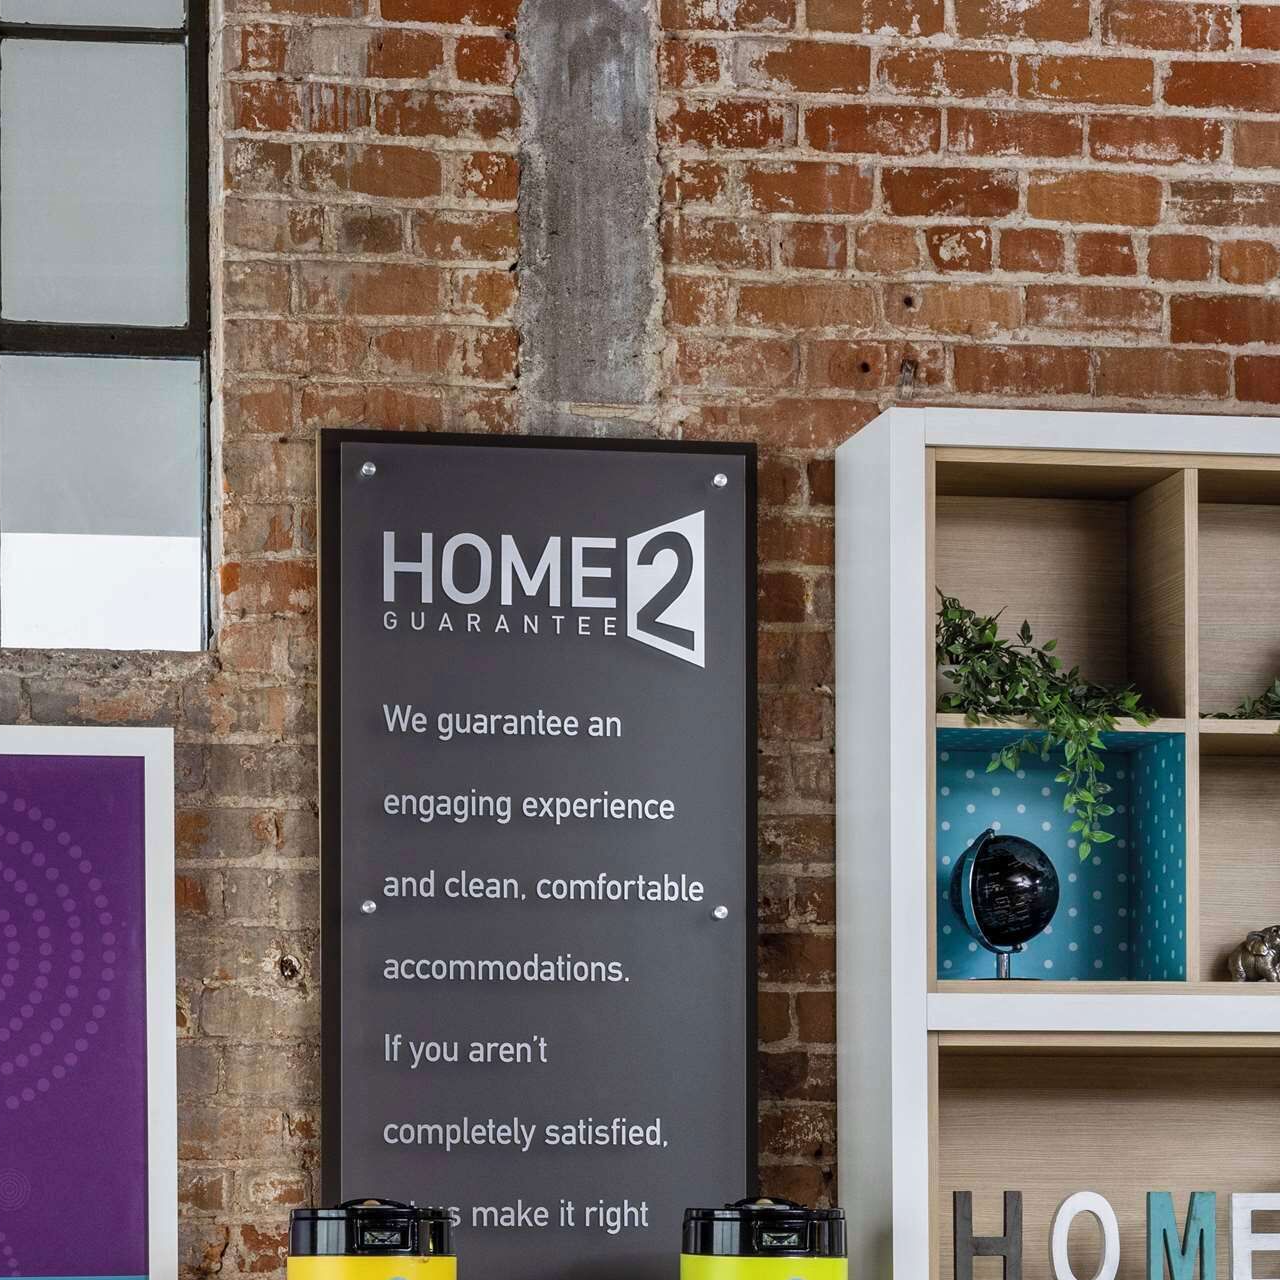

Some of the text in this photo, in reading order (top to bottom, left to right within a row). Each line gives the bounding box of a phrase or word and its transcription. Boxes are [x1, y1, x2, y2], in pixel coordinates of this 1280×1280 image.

[384, 611, 617, 636] GUARANTEE
[383, 704, 622, 741] We guarantee an
[384, 788, 675, 825] engaging experience
[383, 869, 705, 902] and clean, comfortable
[383, 953, 631, 983] accommodations.
[384, 1033, 548, 1069] If you aren't
[383, 1116, 669, 1152] completely satisfied,
[472, 1199, 549, 1228] make
[560, 1199, 576, 1227] it
[585, 1199, 649, 1235] right
